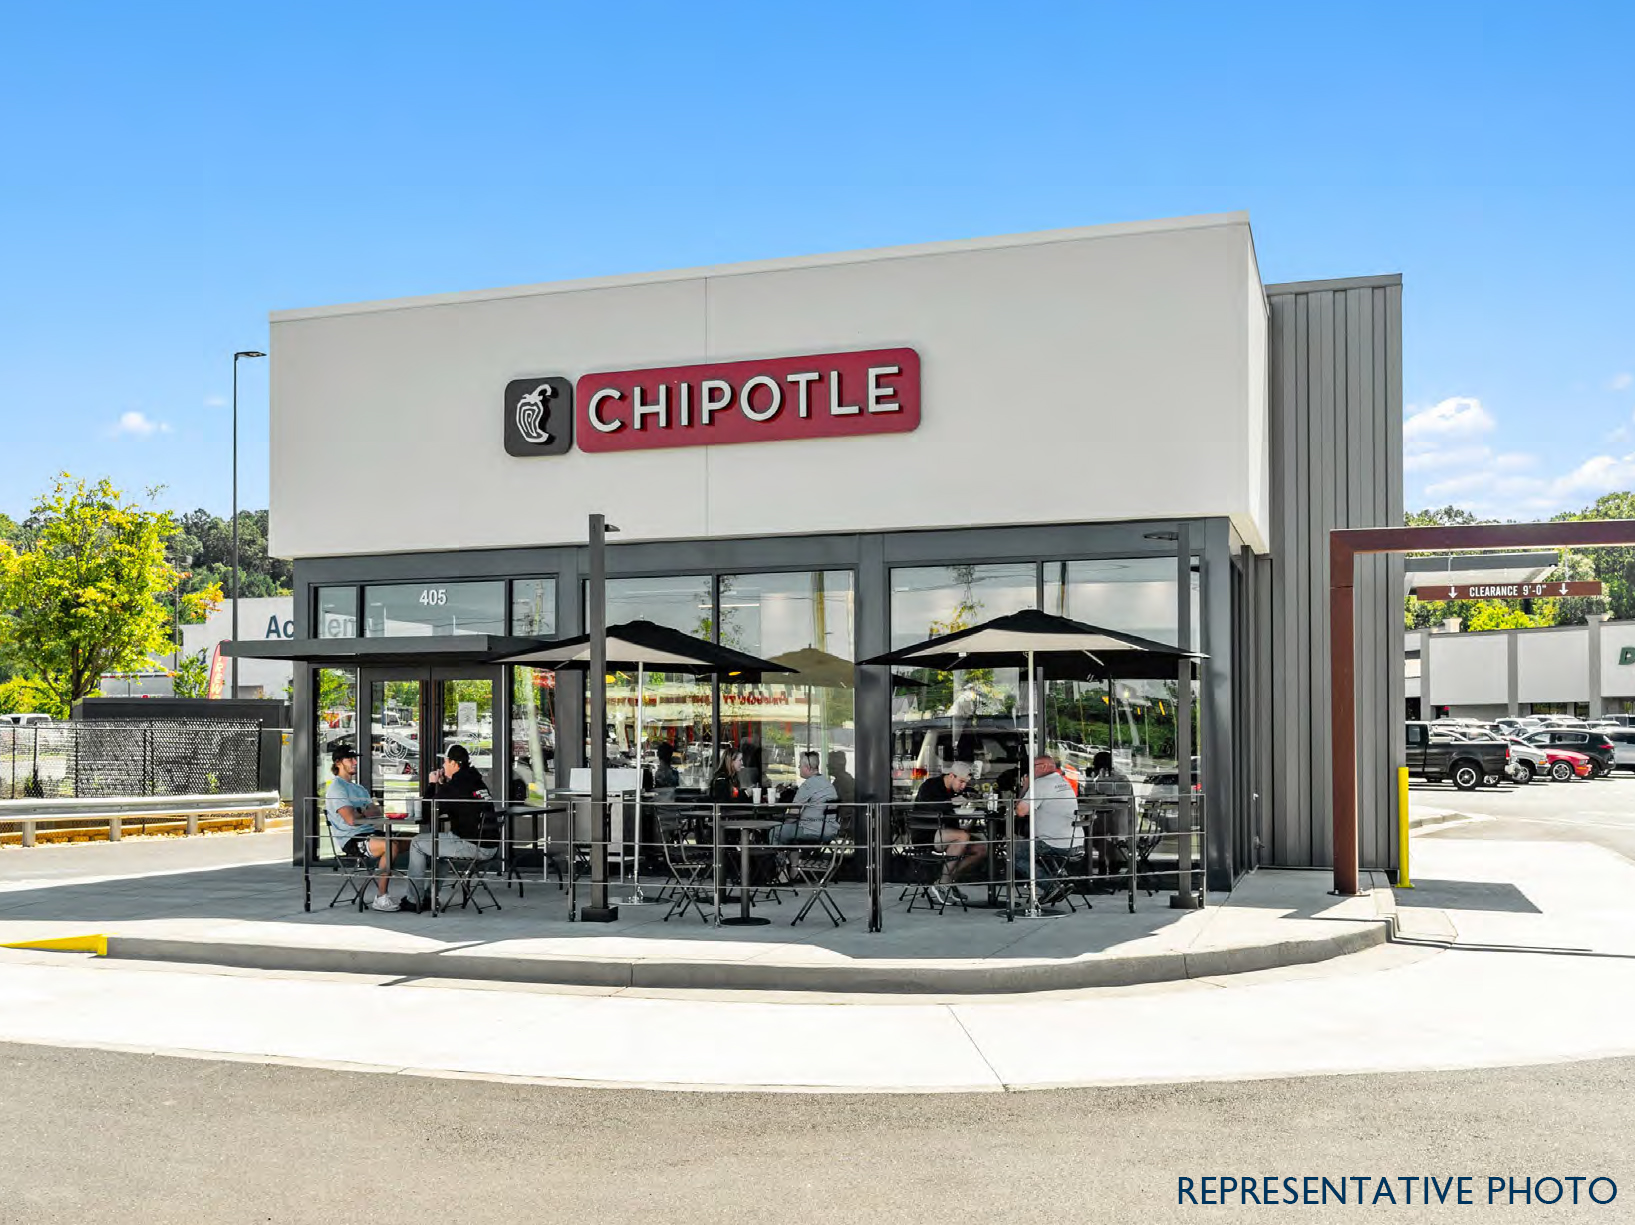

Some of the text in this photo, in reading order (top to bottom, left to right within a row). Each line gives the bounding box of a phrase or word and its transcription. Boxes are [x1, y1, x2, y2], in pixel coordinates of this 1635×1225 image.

[588, 366, 900, 432] CHIPOTLE
[419, 589, 447, 605] 405
[1469, 585, 1518, 597] CLEARANCE
